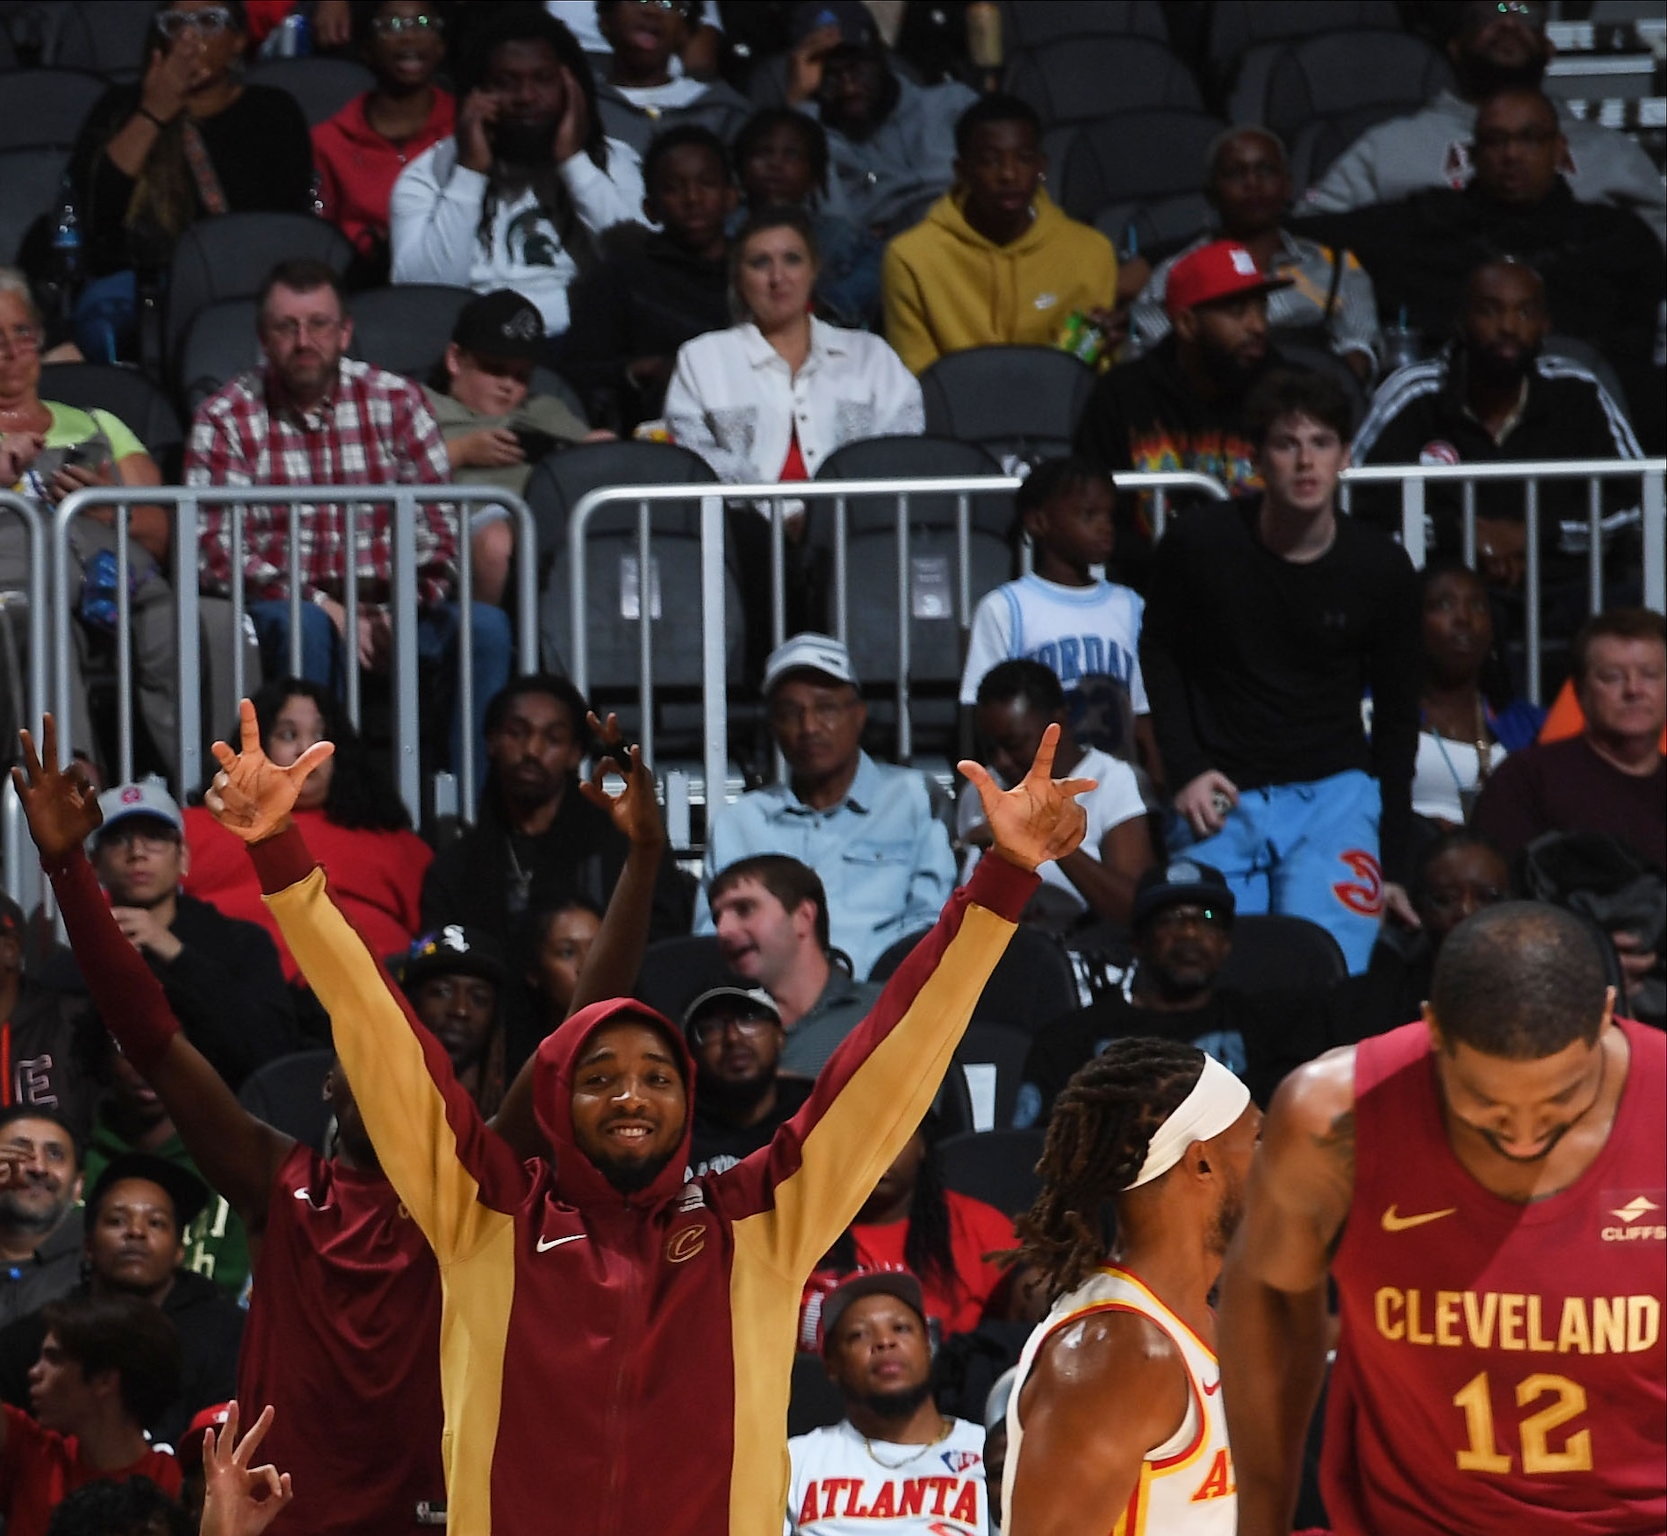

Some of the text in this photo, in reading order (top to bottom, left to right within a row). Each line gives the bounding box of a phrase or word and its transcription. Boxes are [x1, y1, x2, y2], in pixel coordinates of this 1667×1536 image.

[1601, 1226, 1667, 1242] CLIFFS
[1374, 1285, 1662, 1355] CLEVELAND
[1453, 1371, 1594, 1476] 12
[797, 1476, 978, 1528] ATLANTA
